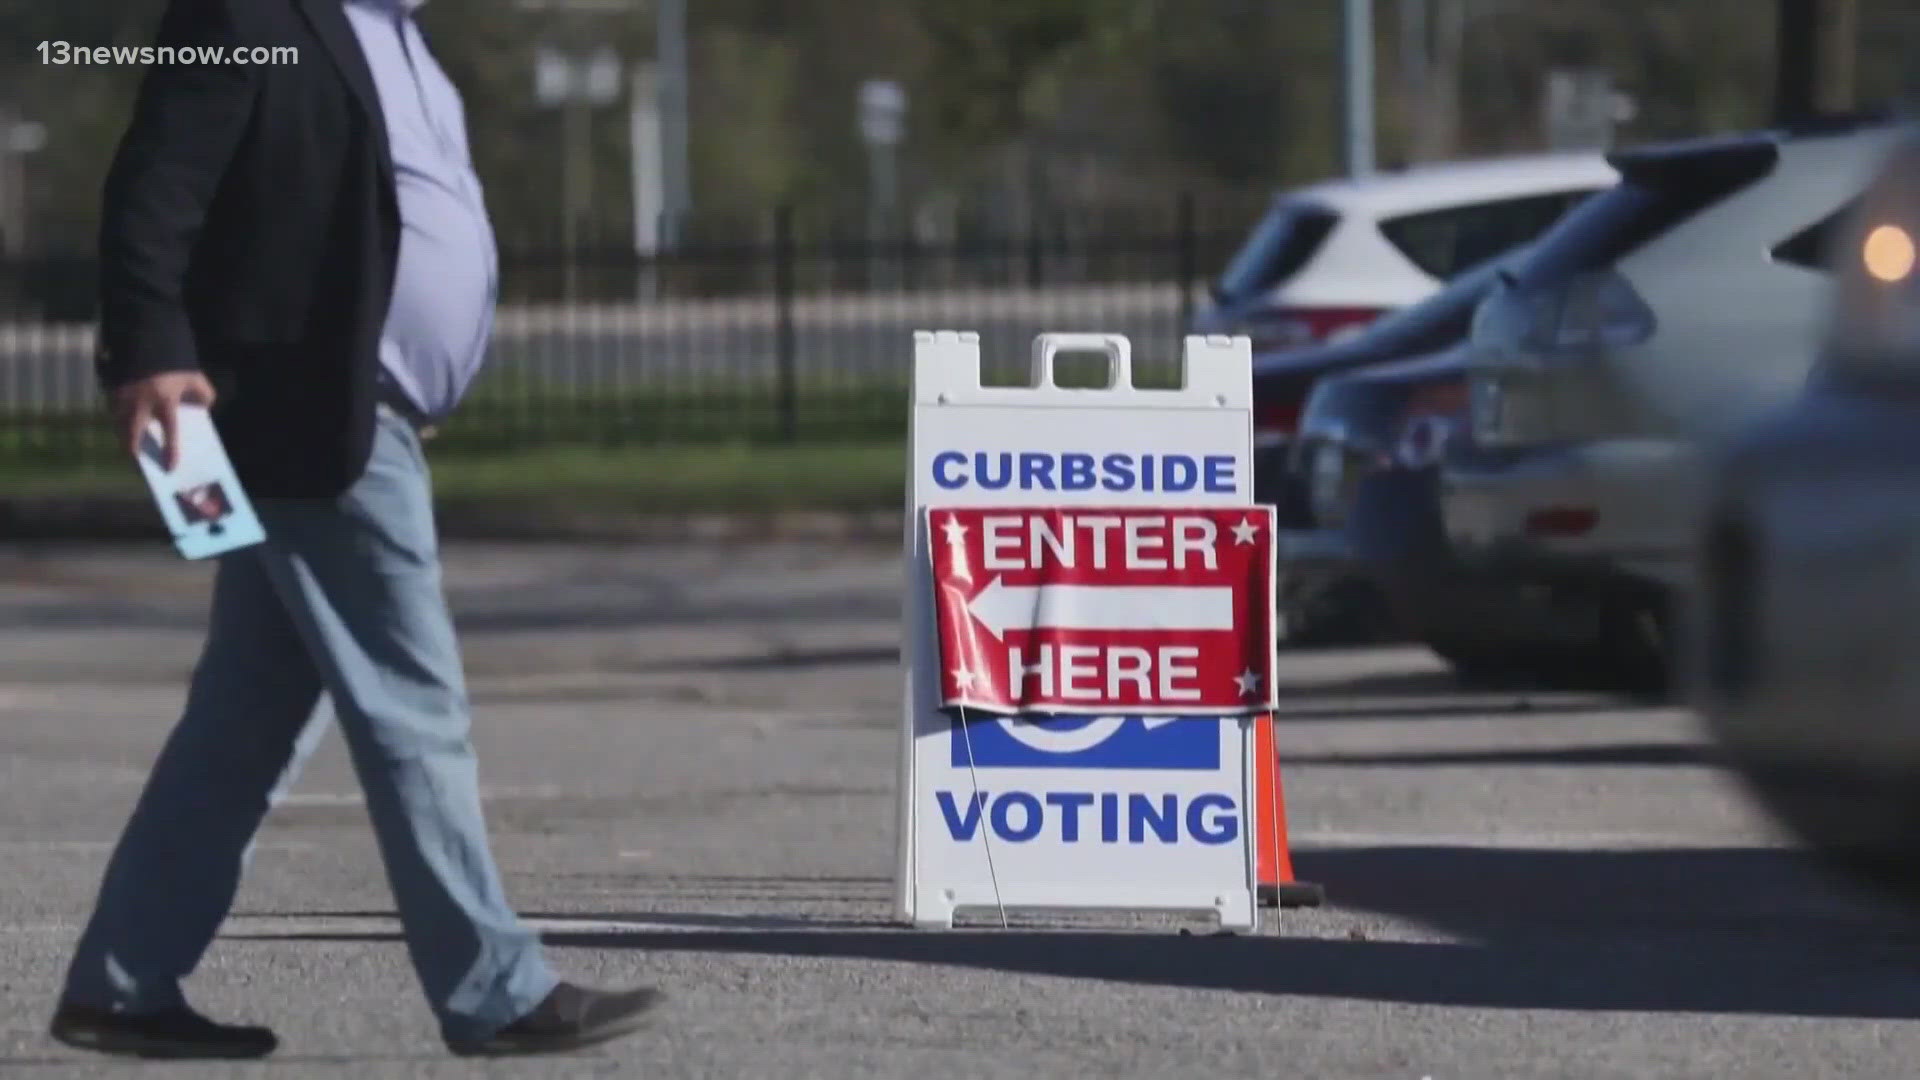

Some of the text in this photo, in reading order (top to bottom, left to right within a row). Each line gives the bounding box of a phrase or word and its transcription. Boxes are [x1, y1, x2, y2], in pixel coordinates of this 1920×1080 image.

[932, 451, 1237, 493] CURBSIDE
[982, 515, 1219, 571] ENTER
[1008, 644, 1202, 700] HERE
[935, 790, 1239, 845] VOTING
